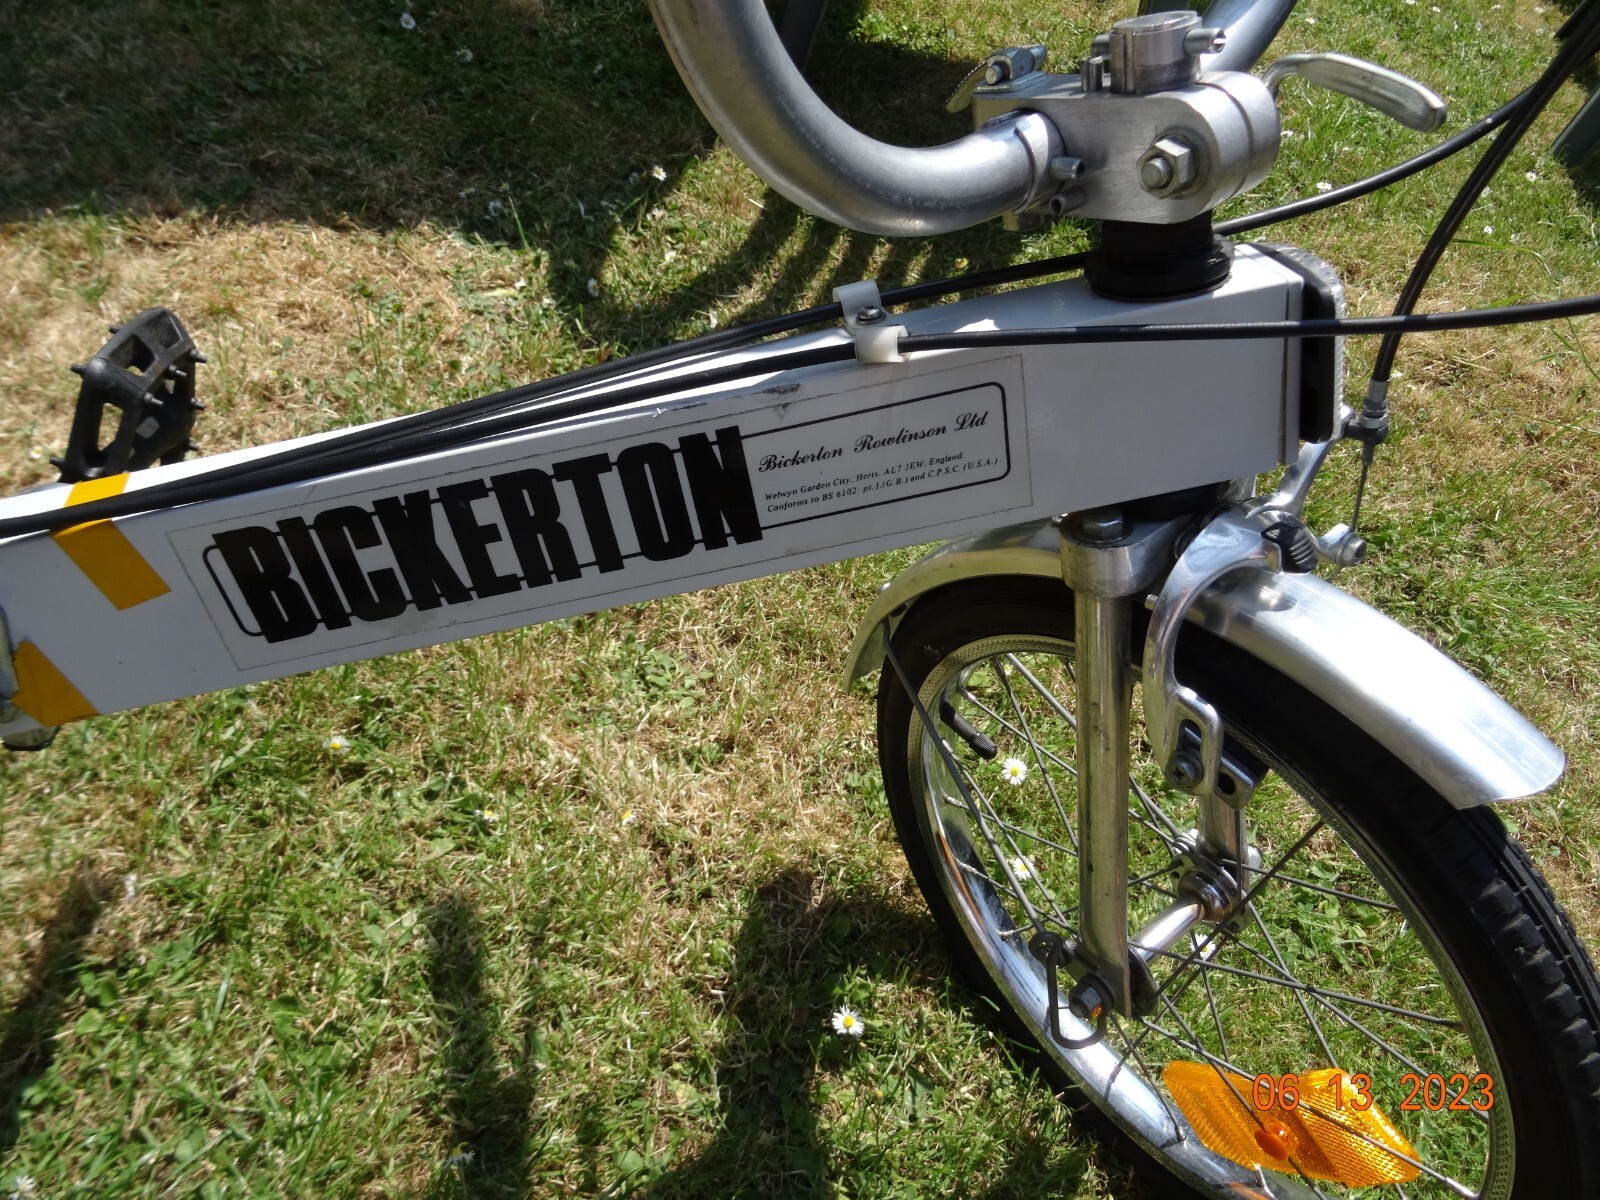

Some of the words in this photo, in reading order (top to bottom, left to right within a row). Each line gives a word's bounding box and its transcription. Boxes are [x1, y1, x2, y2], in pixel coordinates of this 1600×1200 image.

[758, 446, 844, 473] Bickerton
[854, 424, 947, 453] Rowlinson
[953, 411, 990, 432] Ltd
[765, 488, 798, 501] Welwyn
[800, 481, 831, 494] Garden
[883, 464, 902, 475] AL7
[767, 499, 809, 513] Conforms
[811, 496, 820, 504] to
[822, 491, 834, 502] BS
[909, 472, 926, 482] and
[212, 425, 764, 643] BICKERTON
